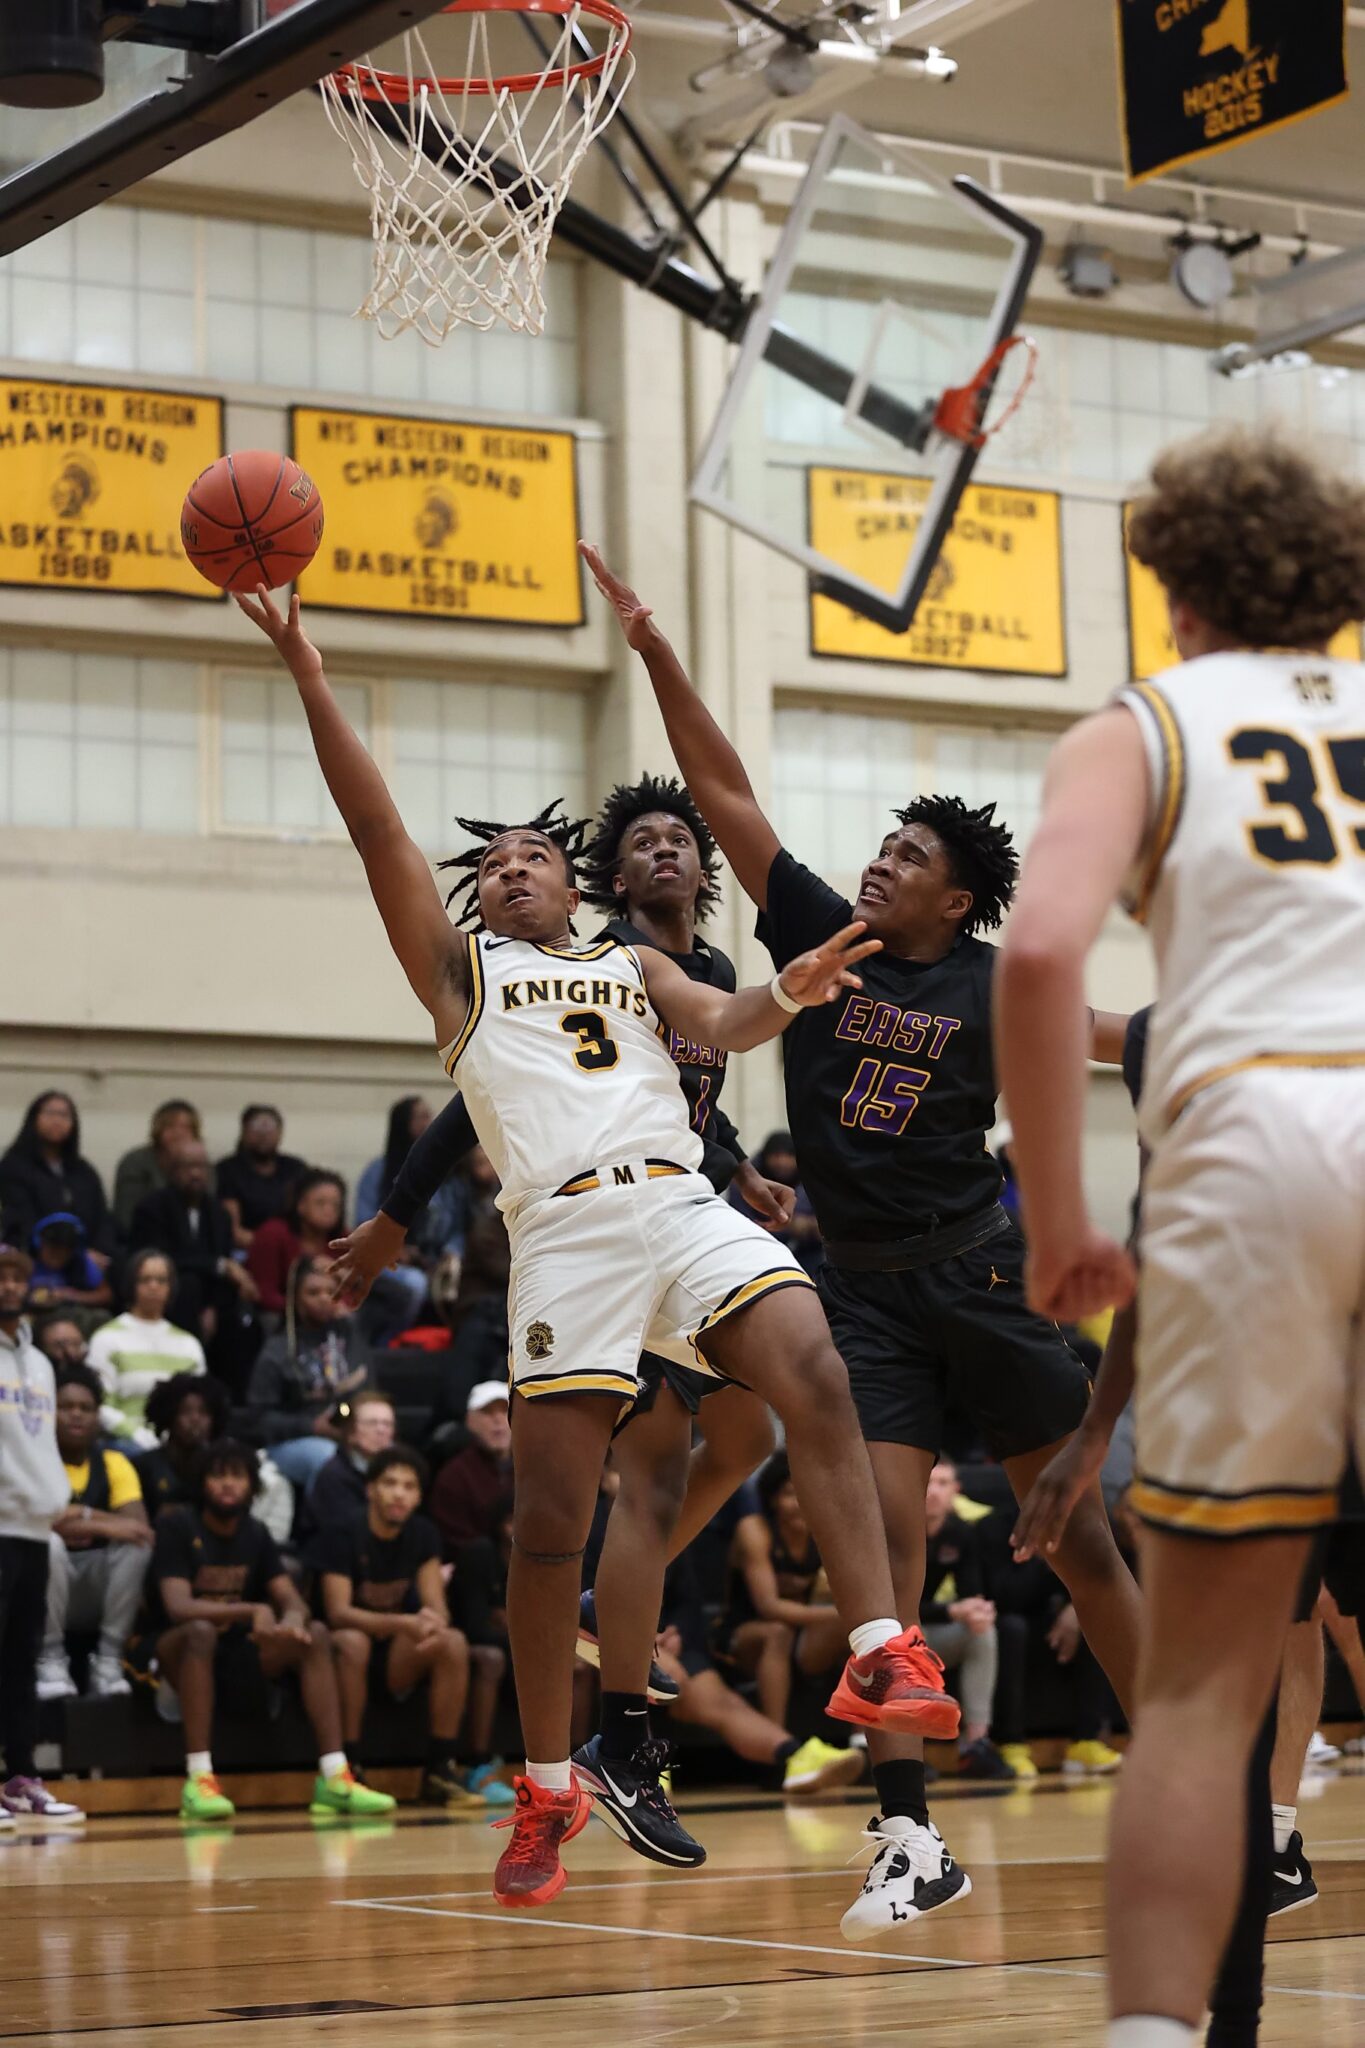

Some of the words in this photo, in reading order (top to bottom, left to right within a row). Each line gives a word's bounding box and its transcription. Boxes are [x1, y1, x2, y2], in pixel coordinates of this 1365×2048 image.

[1182, 53, 1280, 118] HOCKEY
[1203, 93, 1263, 139] 2015
[8, 389, 106, 418] WESTERN
[123, 397, 197, 427] REGION
[318, 419, 358, 444] NYS
[375, 424, 465, 453] WESTERN
[481, 435, 550, 463] REGION
[342, 456, 524, 500] CHAMPIONS
[0, 522, 184, 560] SKETBALL
[333, 547, 543, 590] BASKETBALL
[501, 978, 649, 1018] KNIGHTS
[558, 1008, 622, 1074] 3
[835, 994, 962, 1060] EAST
[689, 1074, 710, 1136] 1
[840, 1057, 932, 1136] 15
[613, 1164, 636, 1186] M
